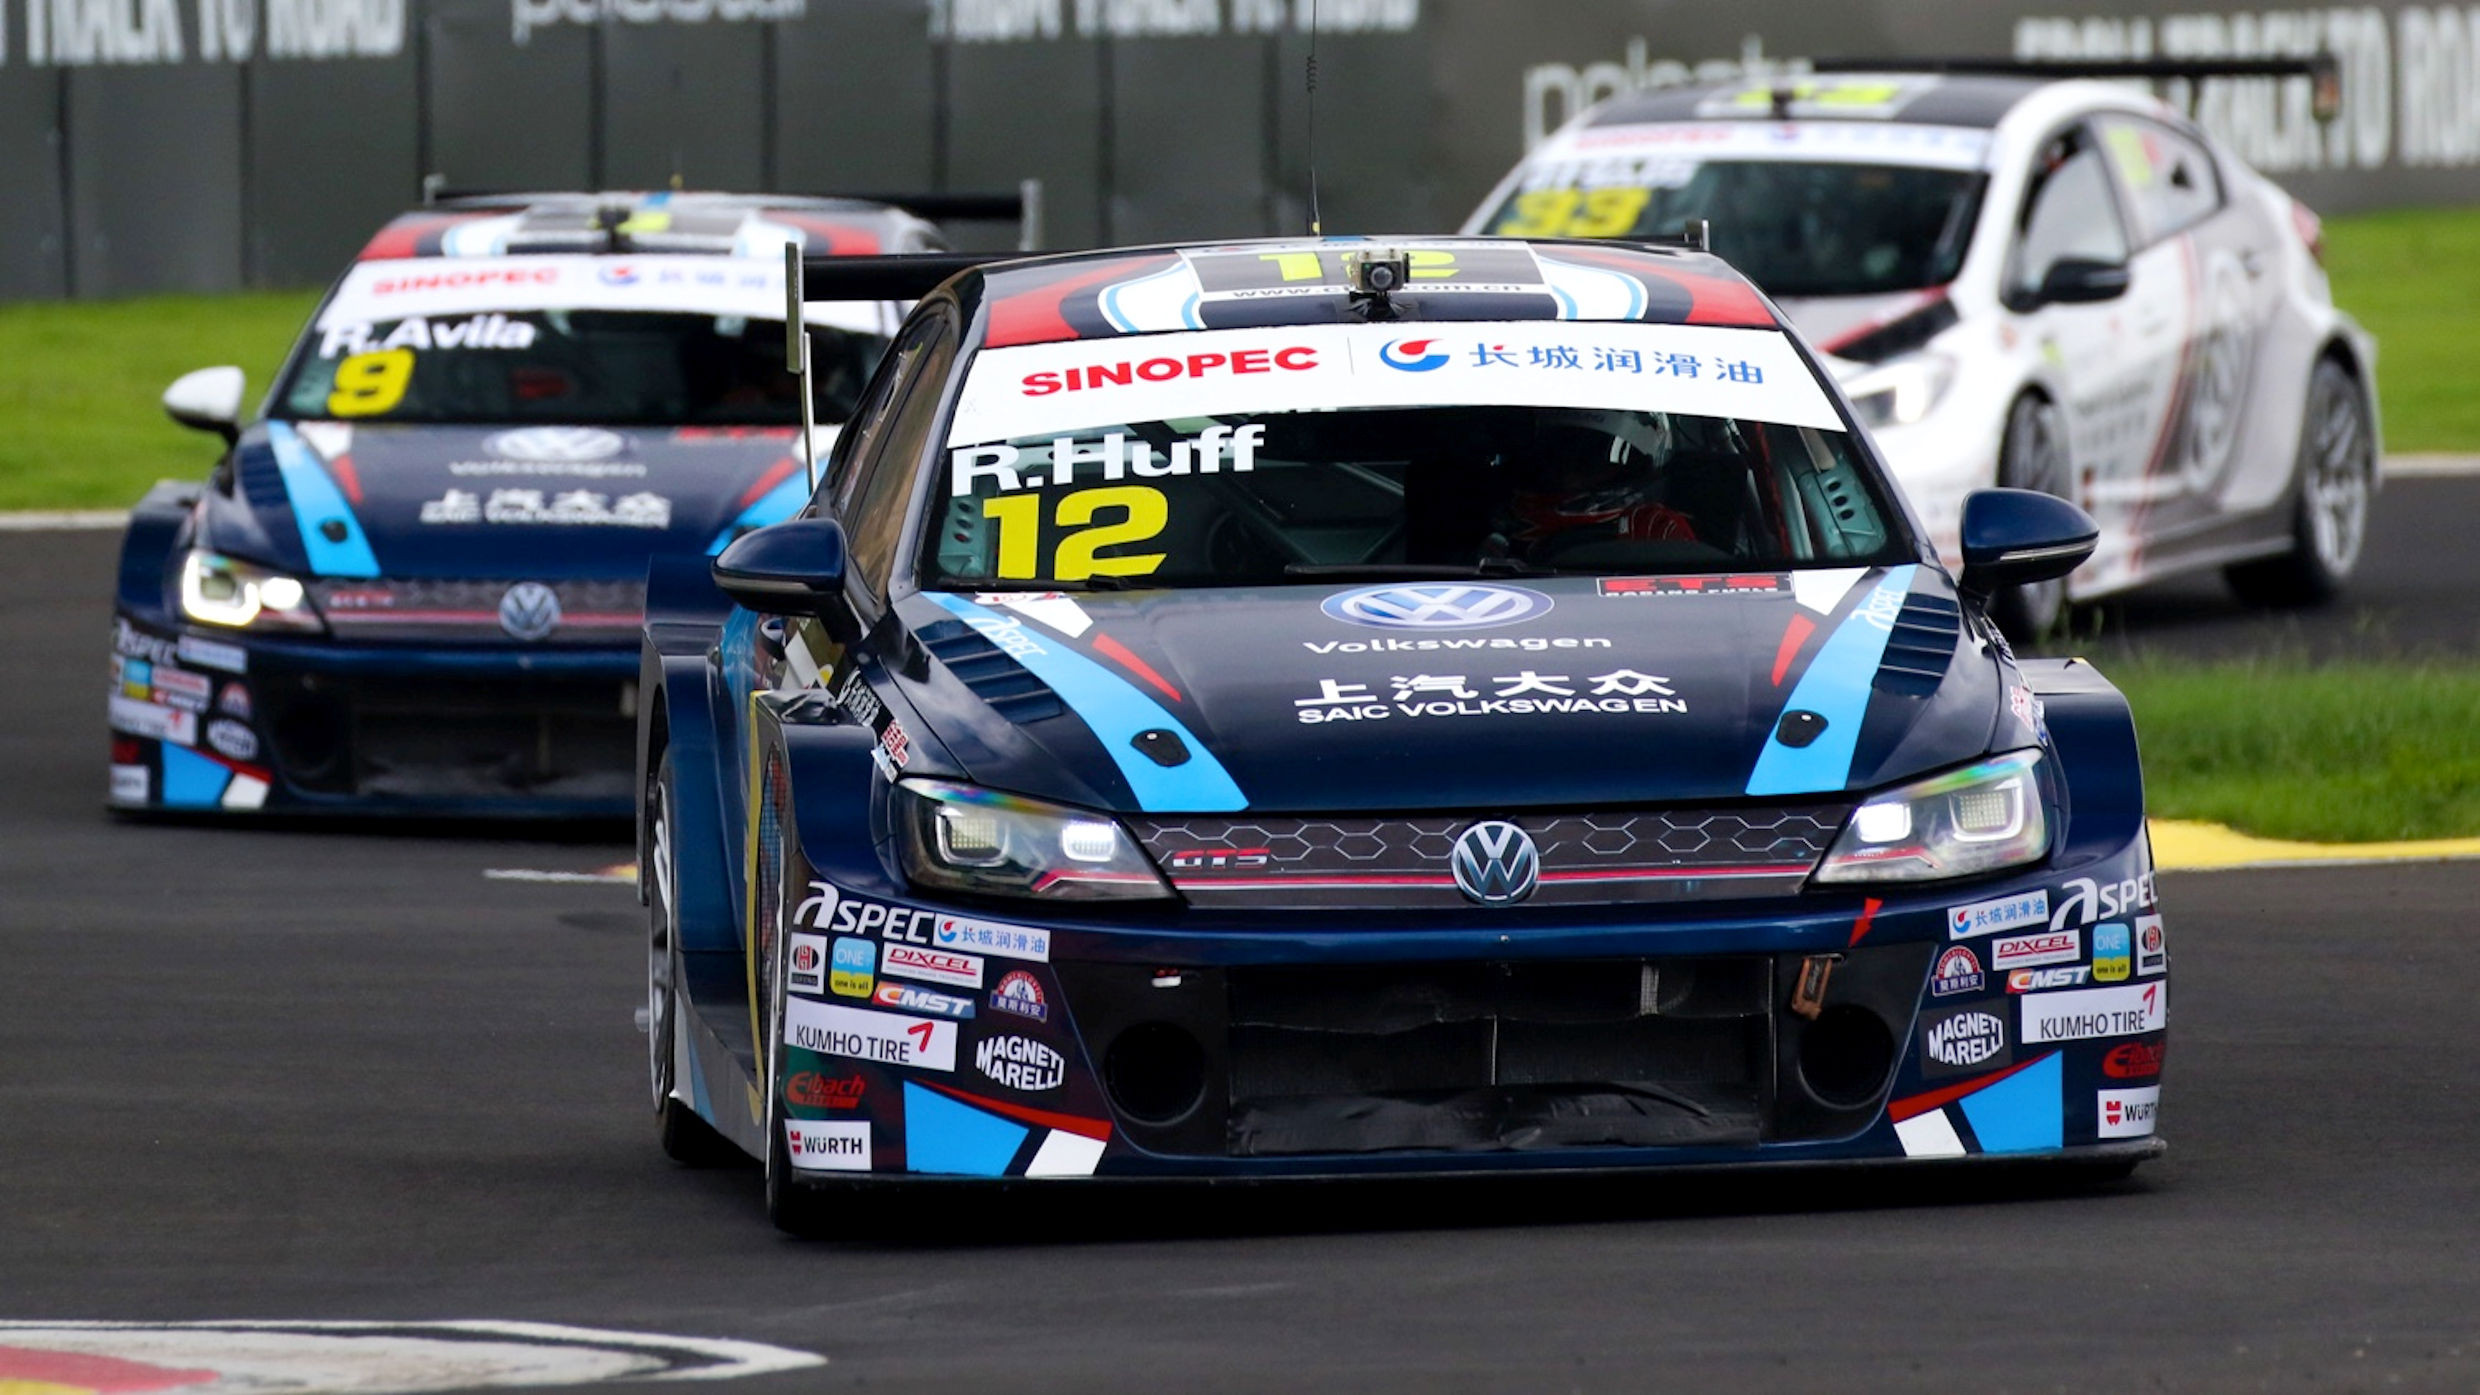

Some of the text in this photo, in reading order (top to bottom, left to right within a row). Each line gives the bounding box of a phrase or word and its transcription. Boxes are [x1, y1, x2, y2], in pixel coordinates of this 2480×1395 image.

[372, 267, 559, 296] SINOPEC
[318, 314, 537, 360] R.Avila
[1021, 347, 1319, 396] SINOPEC
[1469, 342, 1764, 384] 长城润滑油
[327, 347, 417, 418] 9
[951, 424, 1266, 497] R.Huff
[983, 484, 1169, 581] 12
[1303, 635, 1612, 655] Volkswagen
[1294, 668, 1677, 706] 上汽大众
[1297, 697, 1688, 724] SAIC VOLKSWAGEN
[1975, 899, 2046, 928] 长城润滑油
[961, 925, 1046, 954] 长城润滑油
[1999, 935, 2075, 955] DIXCEL
[2095, 935, 2121, 950] ONE
[834, 948, 866, 967] ONE
[888, 948, 977, 972] DIXCEL
[2011, 966, 2091, 990] CMST
[878, 987, 974, 1017] CMST
[1928, 1012, 2004, 1046] MAGNETI
[2041, 1009, 2146, 1039] KUMHO TIRE
[796, 1024, 910, 1063] KUMHO TIRE
[976, 1035, 1065, 1072] MAGNETI
[1929, 1030, 2004, 1066] MARELLI
[977, 1055, 1065, 1091] MARELLI
[804, 1136, 863, 1155] WÜRTH
